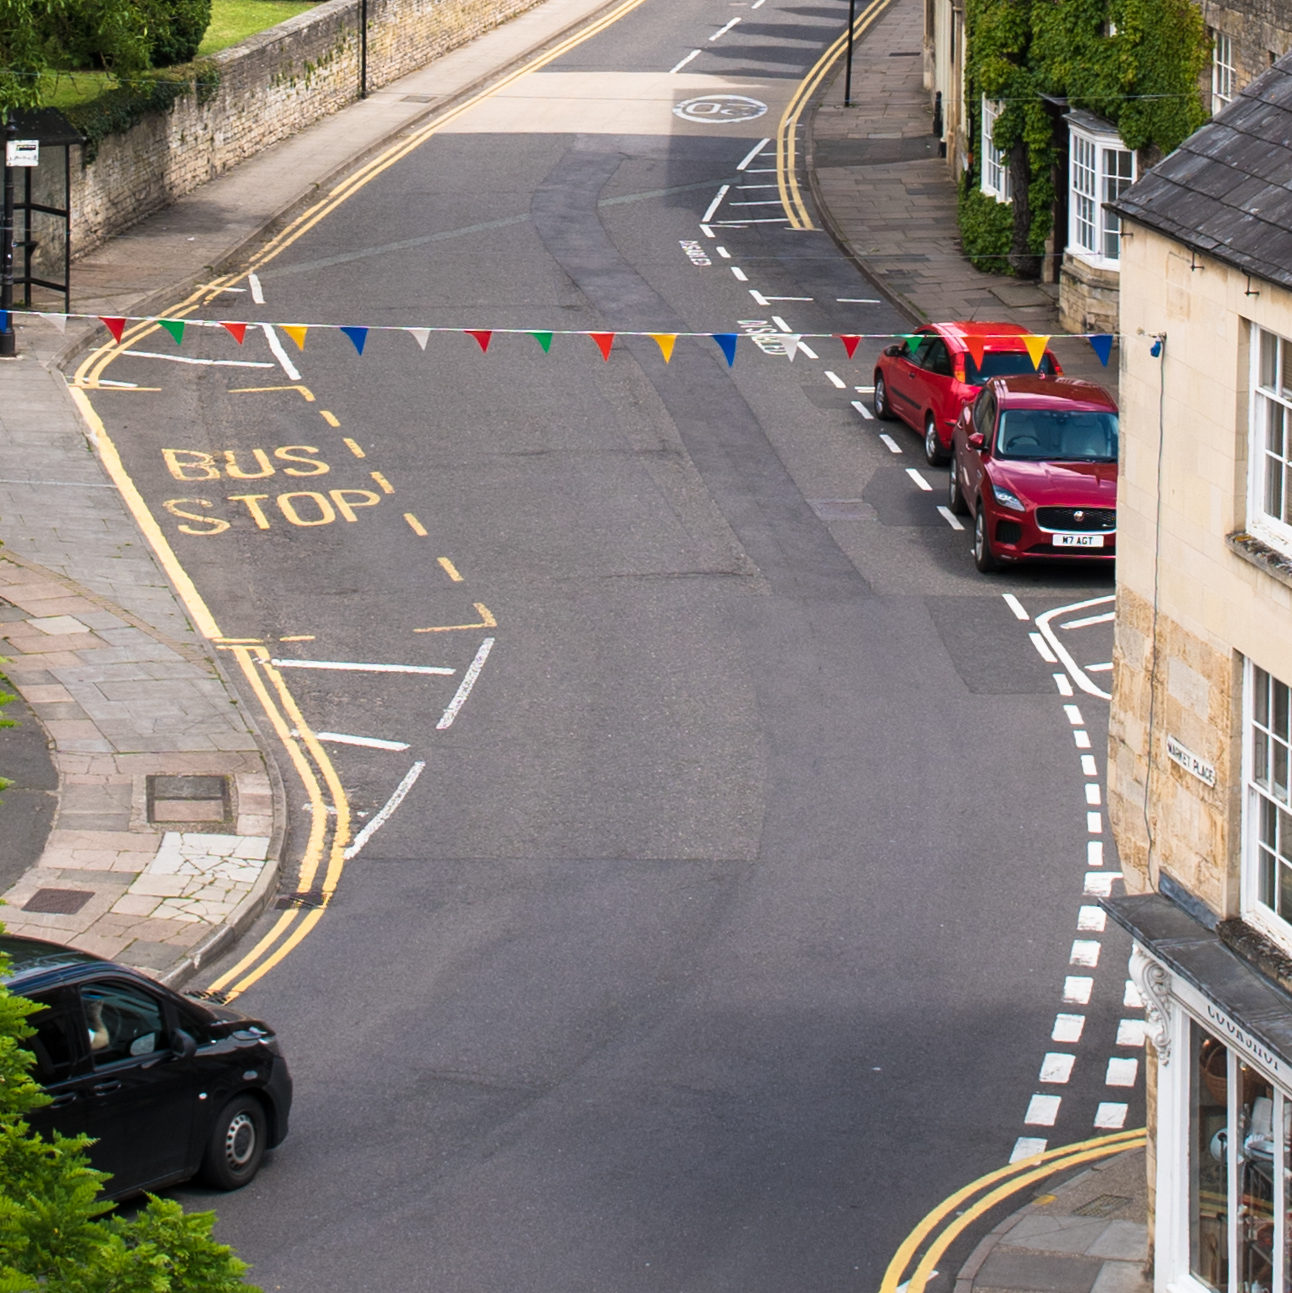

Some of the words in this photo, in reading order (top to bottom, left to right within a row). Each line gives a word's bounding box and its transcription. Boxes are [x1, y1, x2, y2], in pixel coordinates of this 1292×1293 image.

[161, 445, 330, 481] BUS
[162, 488, 380, 535] STOP
[1076, 537, 1093, 545] AGT
[1167, 741, 1191, 767] MARKET
[1193, 759, 1213, 782] PLACE
